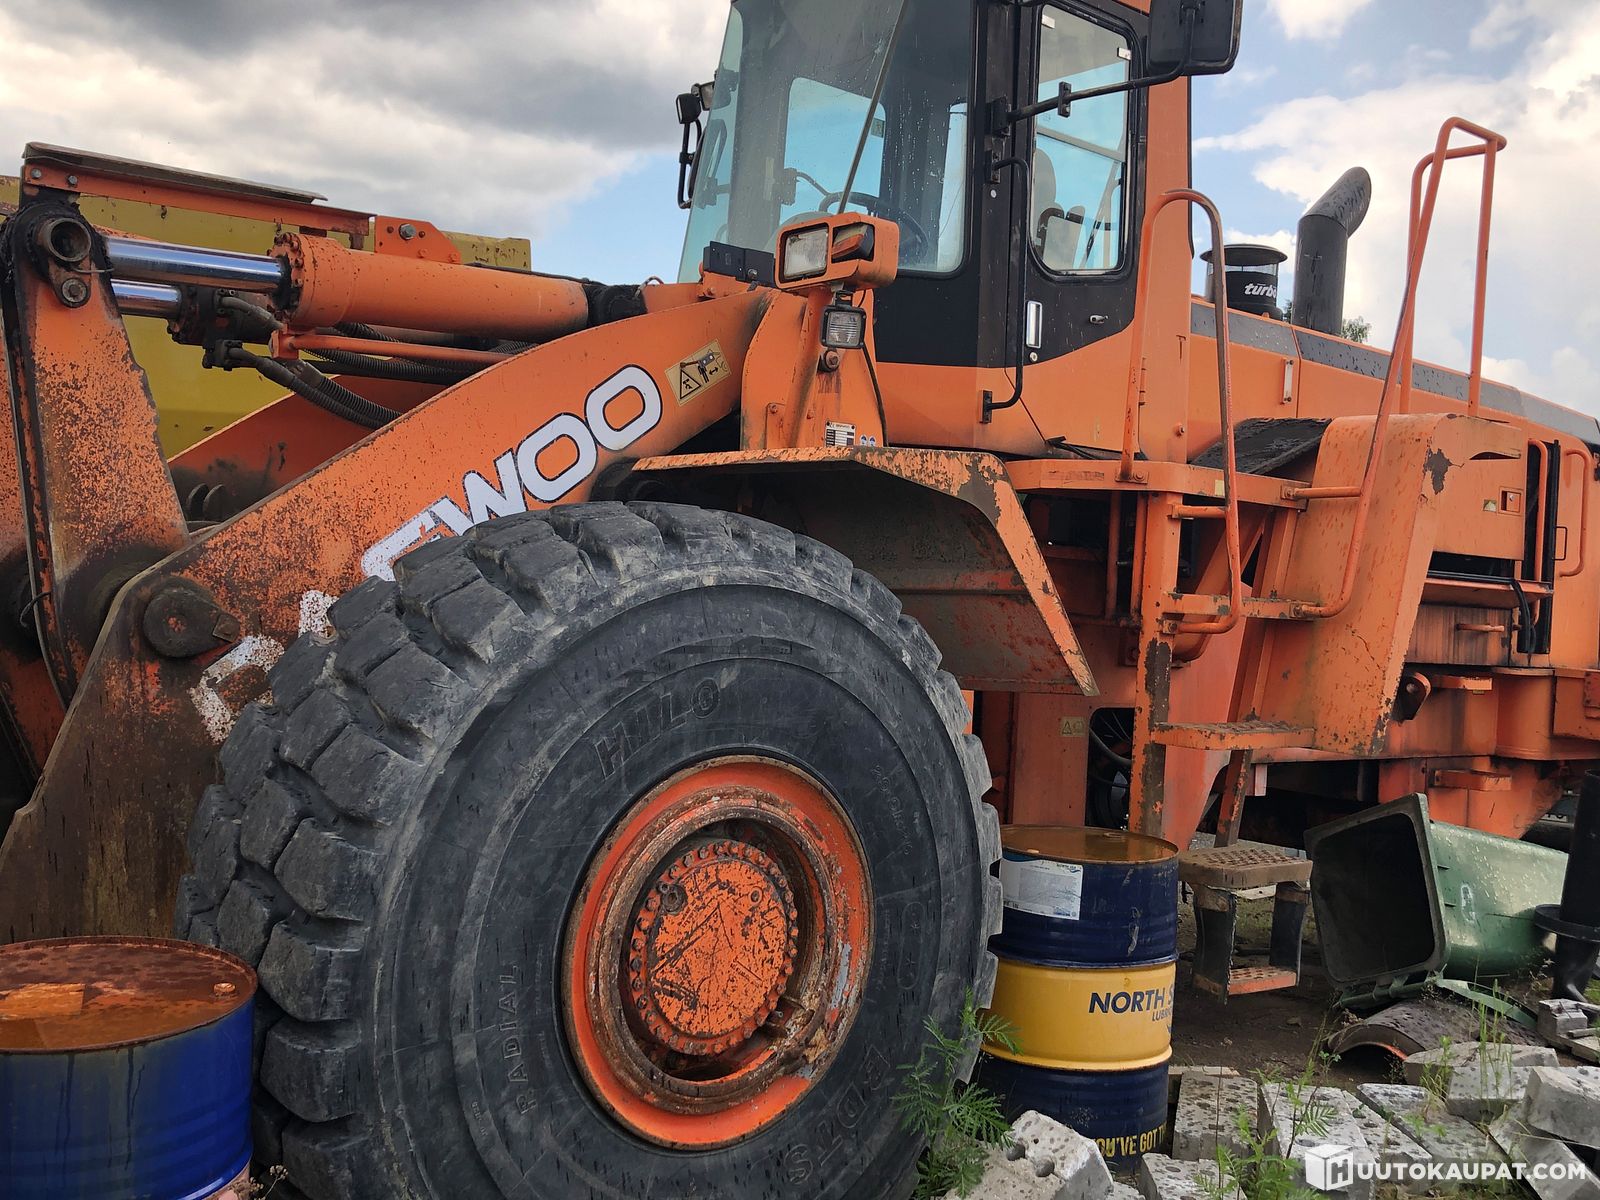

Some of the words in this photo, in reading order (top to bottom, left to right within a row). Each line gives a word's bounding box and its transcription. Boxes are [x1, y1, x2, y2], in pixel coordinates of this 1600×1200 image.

[1088, 986, 1166, 1014] NORTH
[497, 964, 540, 1122] RADIAL
[1093, 1135, 1138, 1158] OU'VE
[1139, 1128, 1158, 1153] GOT
